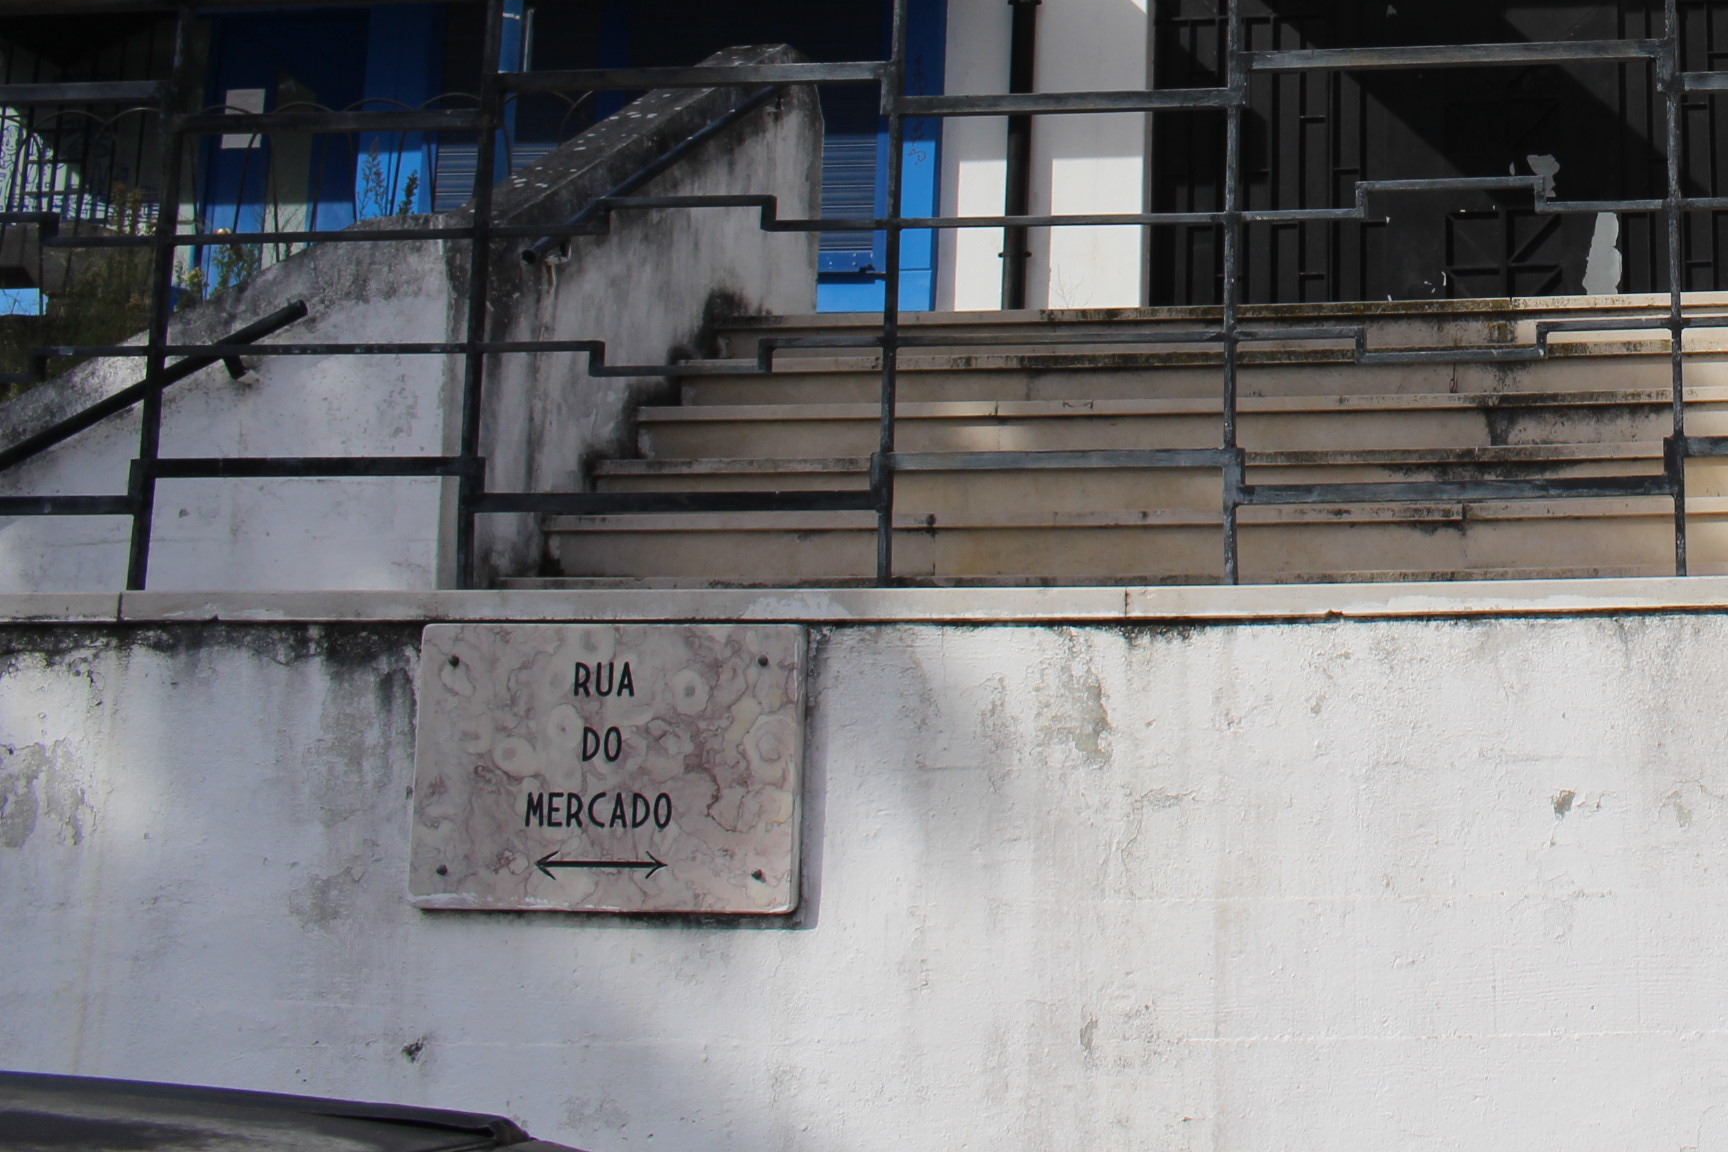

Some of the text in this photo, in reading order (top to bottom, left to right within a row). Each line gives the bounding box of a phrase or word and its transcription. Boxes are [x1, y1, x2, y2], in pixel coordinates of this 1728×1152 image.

[573, 661, 635, 698] RUA
[581, 726, 623, 762] DO
[524, 791, 673, 829] MERCADO
